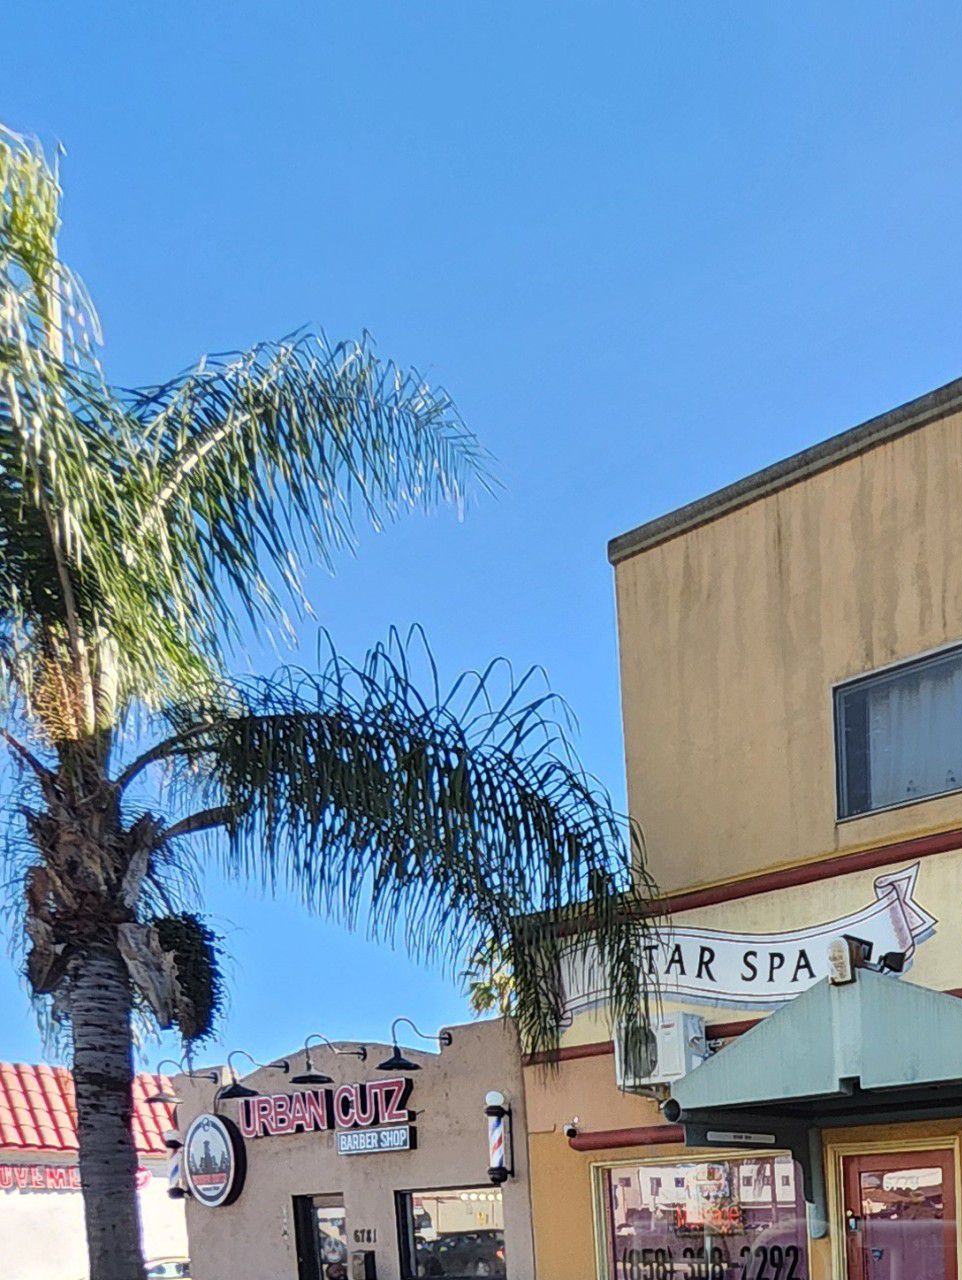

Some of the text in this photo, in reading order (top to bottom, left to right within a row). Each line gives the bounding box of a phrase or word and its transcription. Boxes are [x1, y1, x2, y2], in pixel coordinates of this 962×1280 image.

[641, 942, 818, 982] TAR SPA
[239, 1077, 409, 1138] URBAN CUTZ
[340, 1130, 407, 1150] BARBER SHOP
